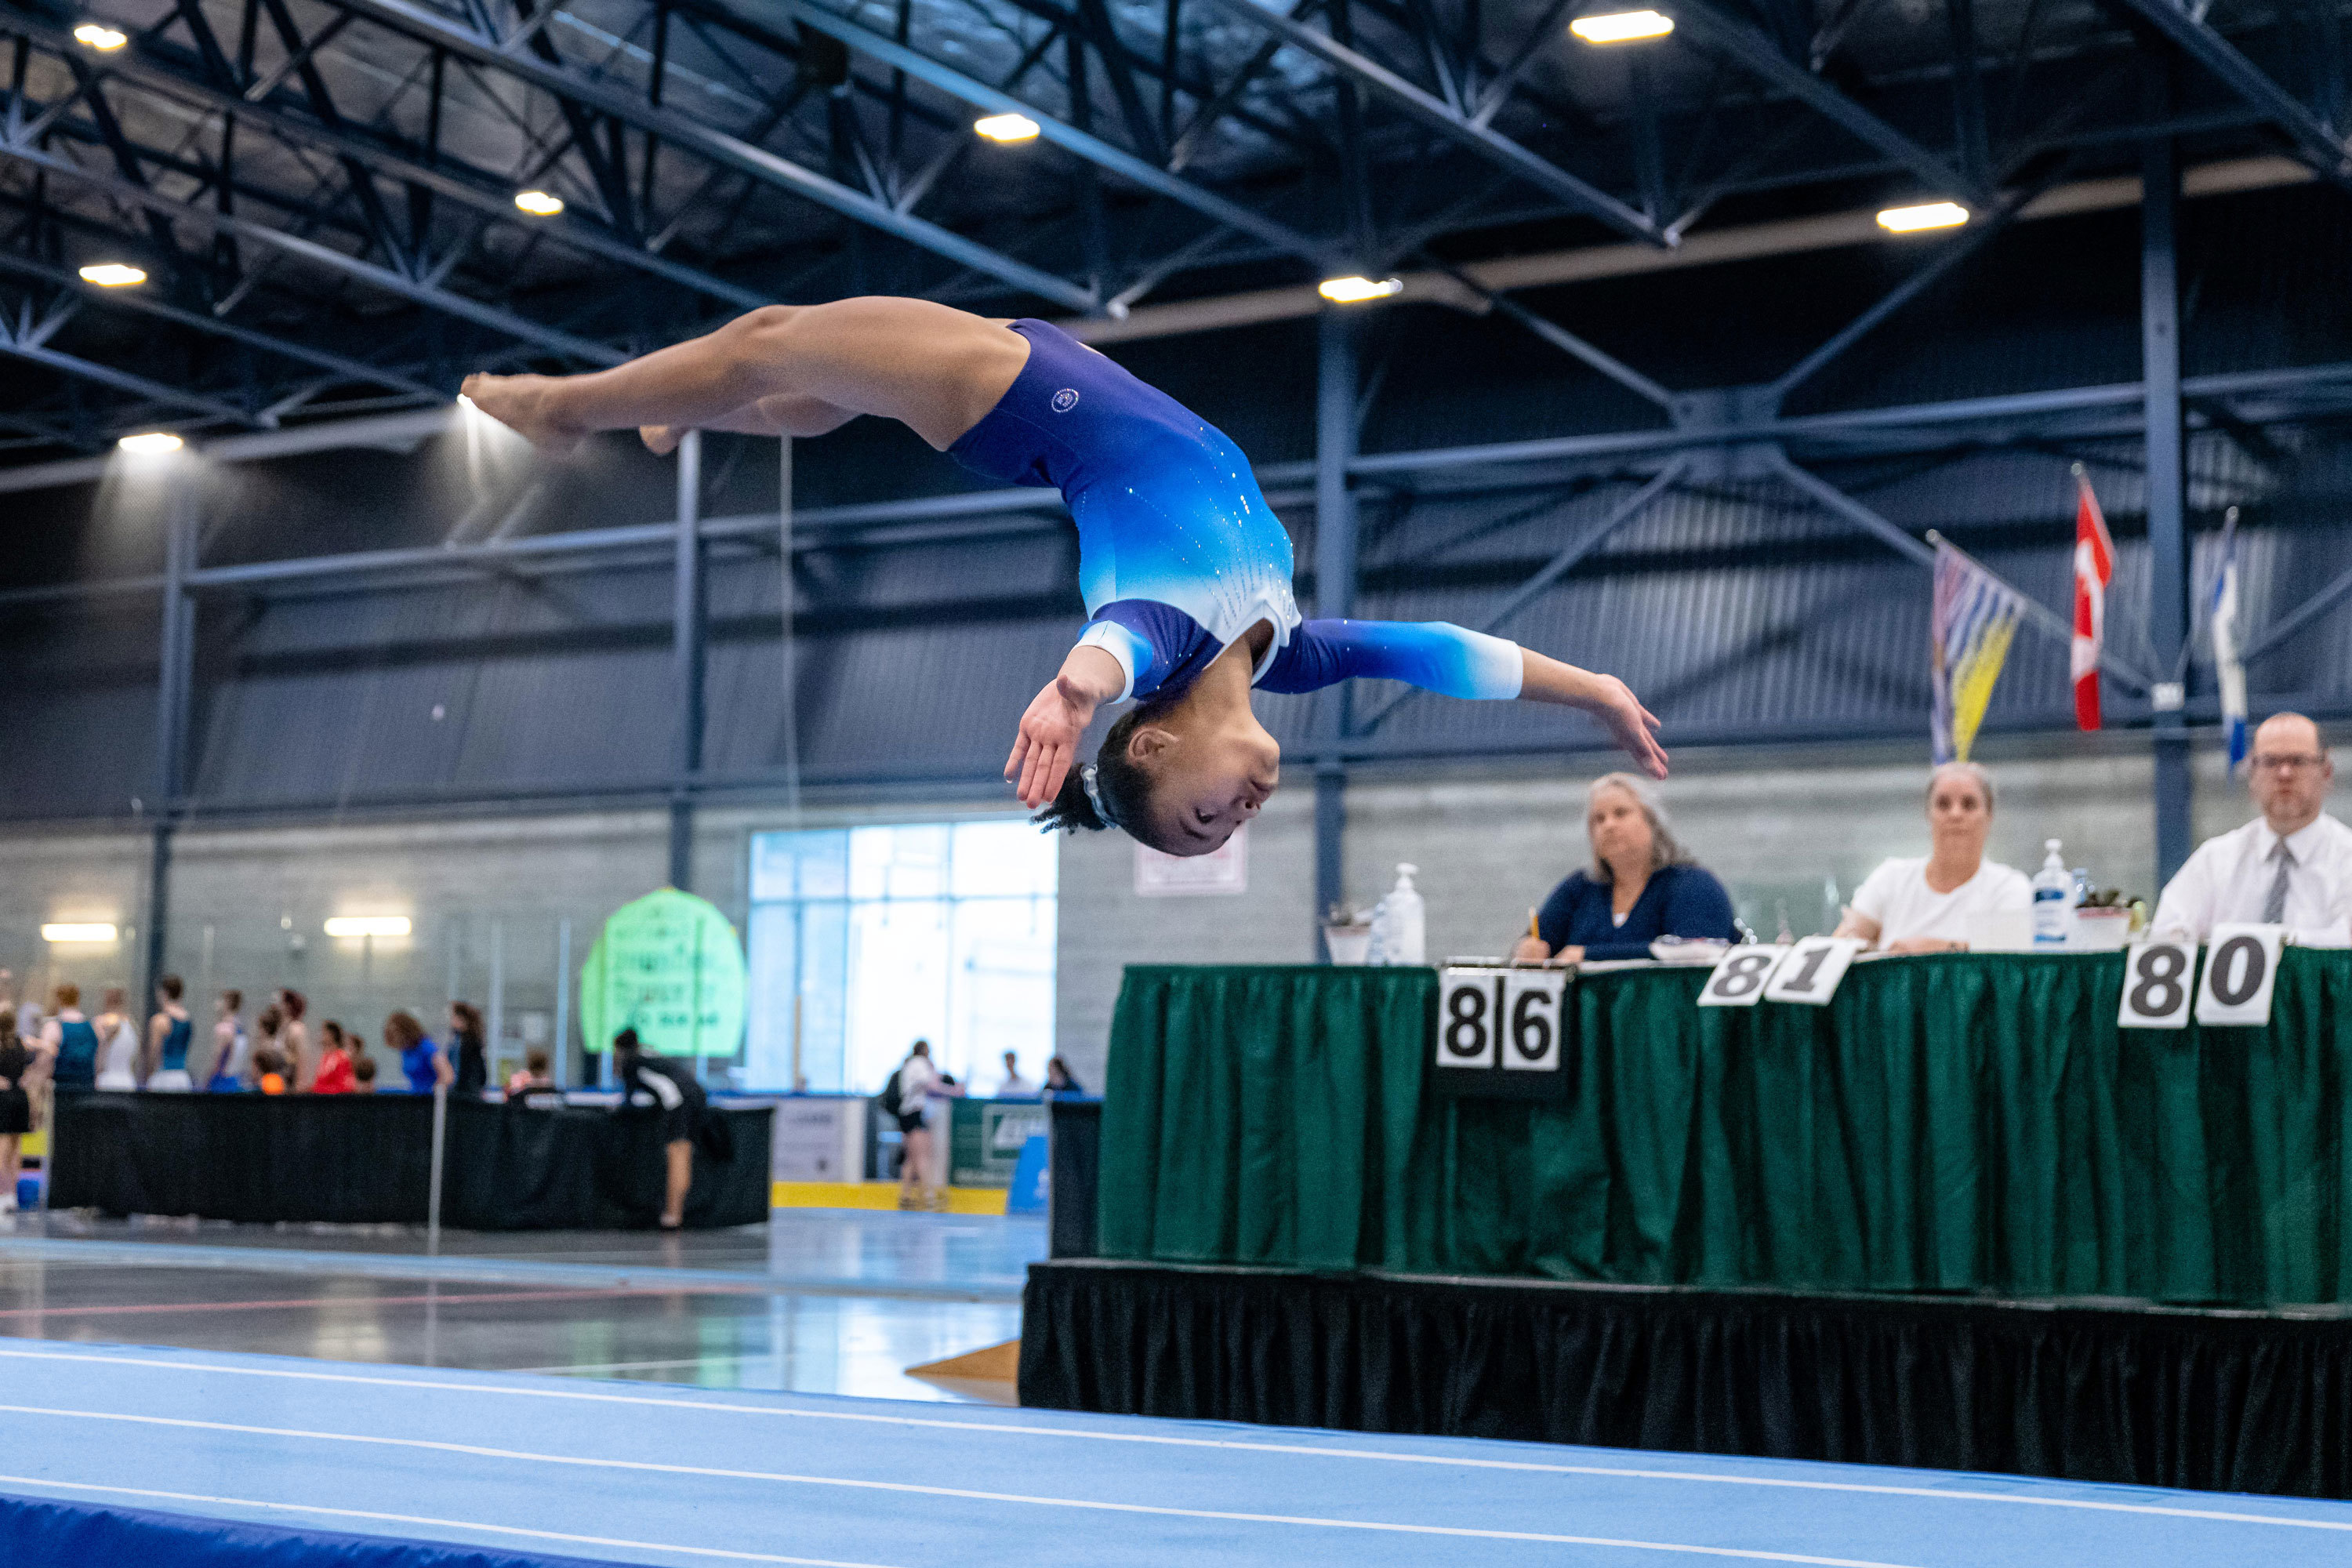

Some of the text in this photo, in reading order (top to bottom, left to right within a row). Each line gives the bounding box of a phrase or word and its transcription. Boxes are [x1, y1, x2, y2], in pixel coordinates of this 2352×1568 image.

[1713, 947, 1832, 996] 81
[2131, 936, 2265, 1017] 80
[1447, 987, 1551, 1060] 86
